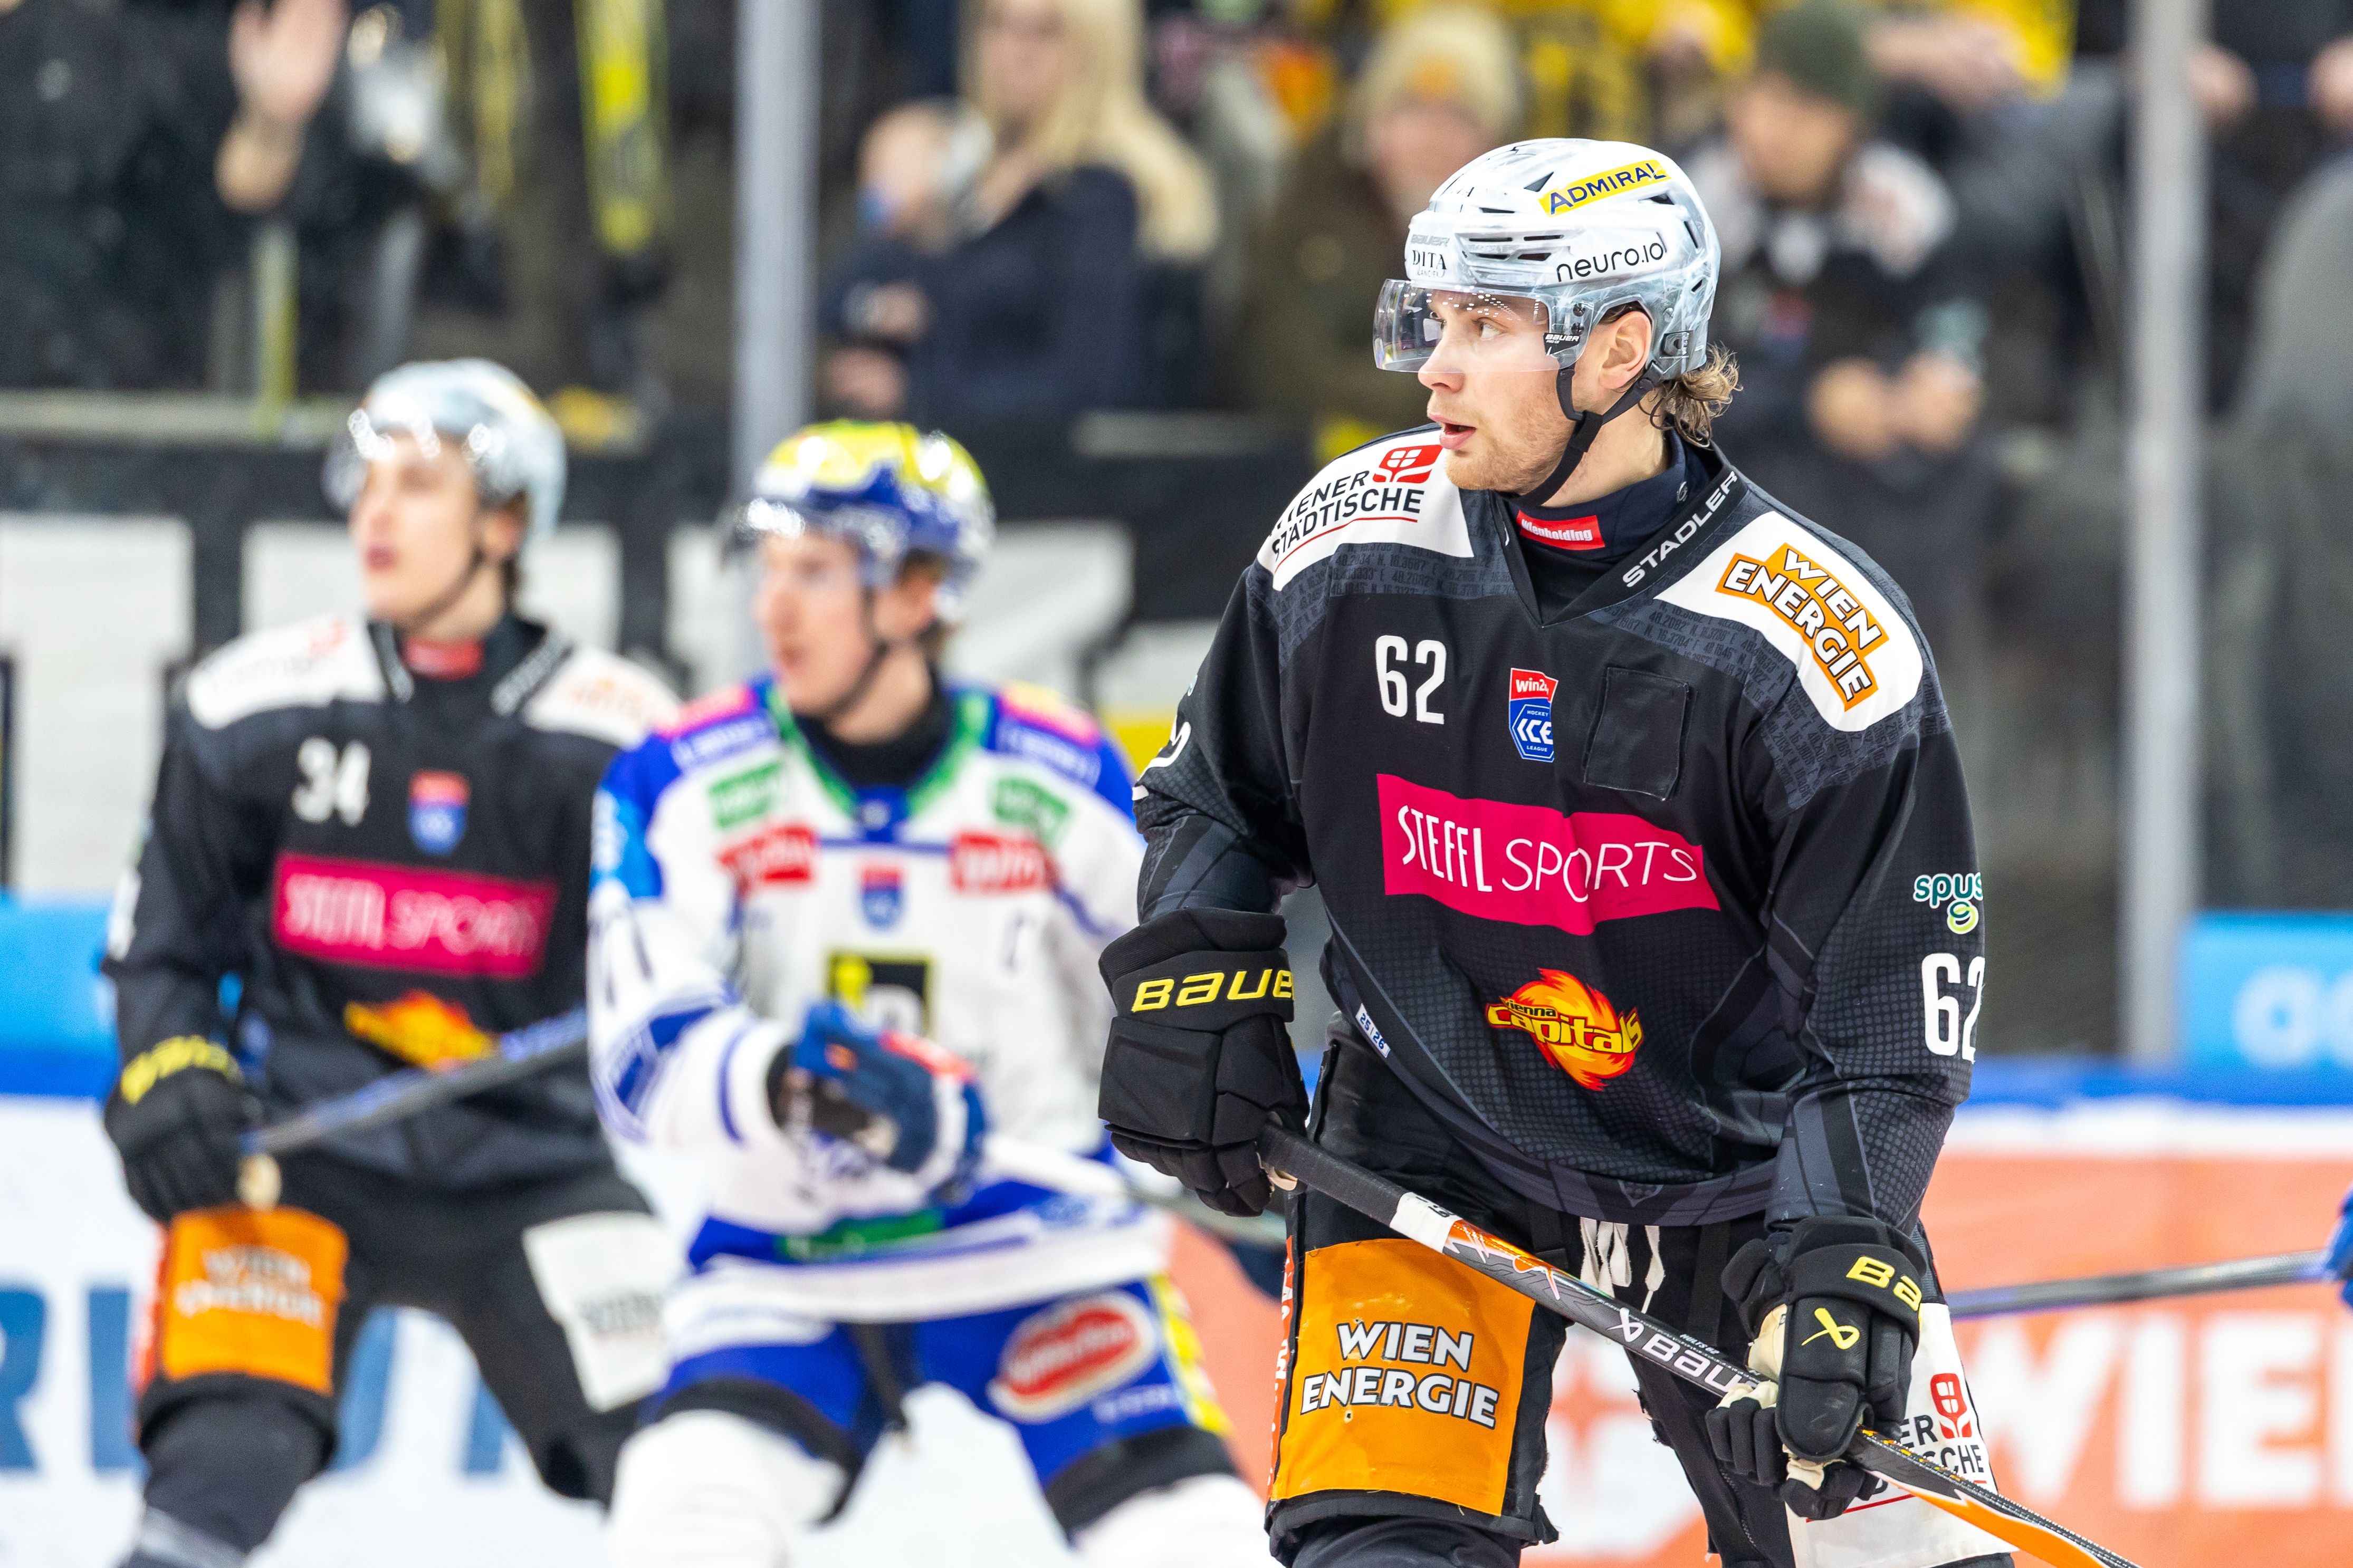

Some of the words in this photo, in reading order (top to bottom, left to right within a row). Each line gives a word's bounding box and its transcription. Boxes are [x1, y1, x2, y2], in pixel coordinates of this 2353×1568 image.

[1550, 163, 1666, 215] ADMIRAL
[1412, 250, 1447, 270] DITA
[1279, 470, 1370, 528] IENER
[1622, 471, 1738, 588] STADLER
[1724, 560, 1872, 701] ENERGIE
[1784, 549, 1882, 649] WIEN
[1375, 635, 1447, 725] 62
[1517, 718, 1554, 745] ICE
[293, 737, 370, 827] 34
[1398, 805, 1493, 892] STEFFL
[1501, 838, 1697, 903] SPORTS
[1132, 968, 1294, 1012] BAUE
[1921, 953, 1985, 1064] 62
[1360, 1013, 1385, 1050] 25/26
[1336, 1321, 1475, 1372] WIEN
[1642, 1332, 1757, 1393] BAU
[1299, 1365, 1500, 1430] ENERGIE
